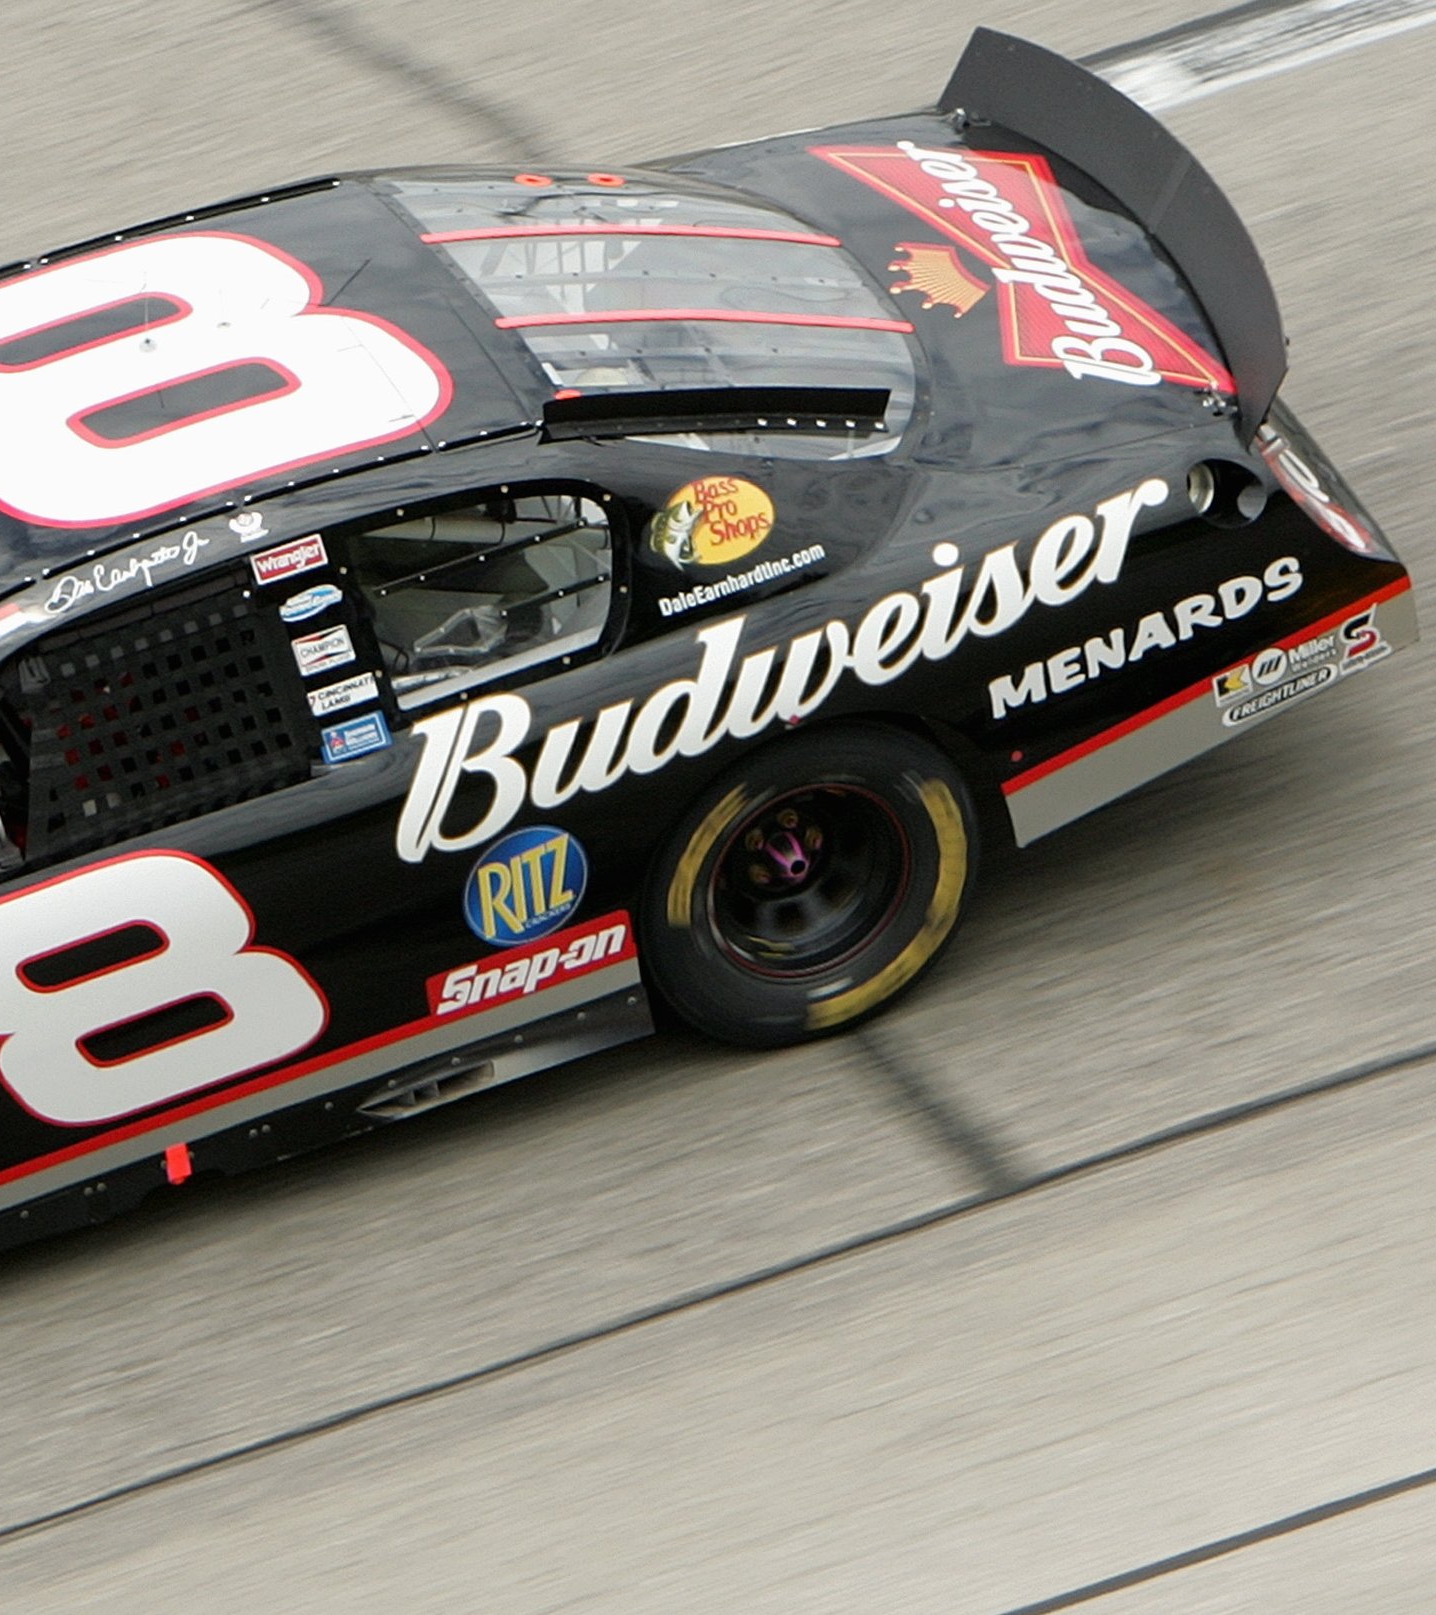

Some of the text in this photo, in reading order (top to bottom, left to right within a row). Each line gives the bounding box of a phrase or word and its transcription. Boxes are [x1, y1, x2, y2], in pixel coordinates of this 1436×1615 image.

[896, 140, 1162, 387] Budweiser
[692, 478, 739, 503] Bass
[700, 499, 738, 524] Pro
[256, 544, 320, 573] Wrangler
[709, 512, 770, 546] Shops
[658, 544, 826, 617] DaleEarnhardtInc.com
[988, 556, 1303, 719] MENARDS
[1288, 635, 1335, 664] Miller
[396, 478, 1168, 862] Budweiser
[1232, 667, 1330, 720] FREIGHTLINER
[477, 833, 574, 940] RITZ
[436, 924, 627, 1015] Snap-on
